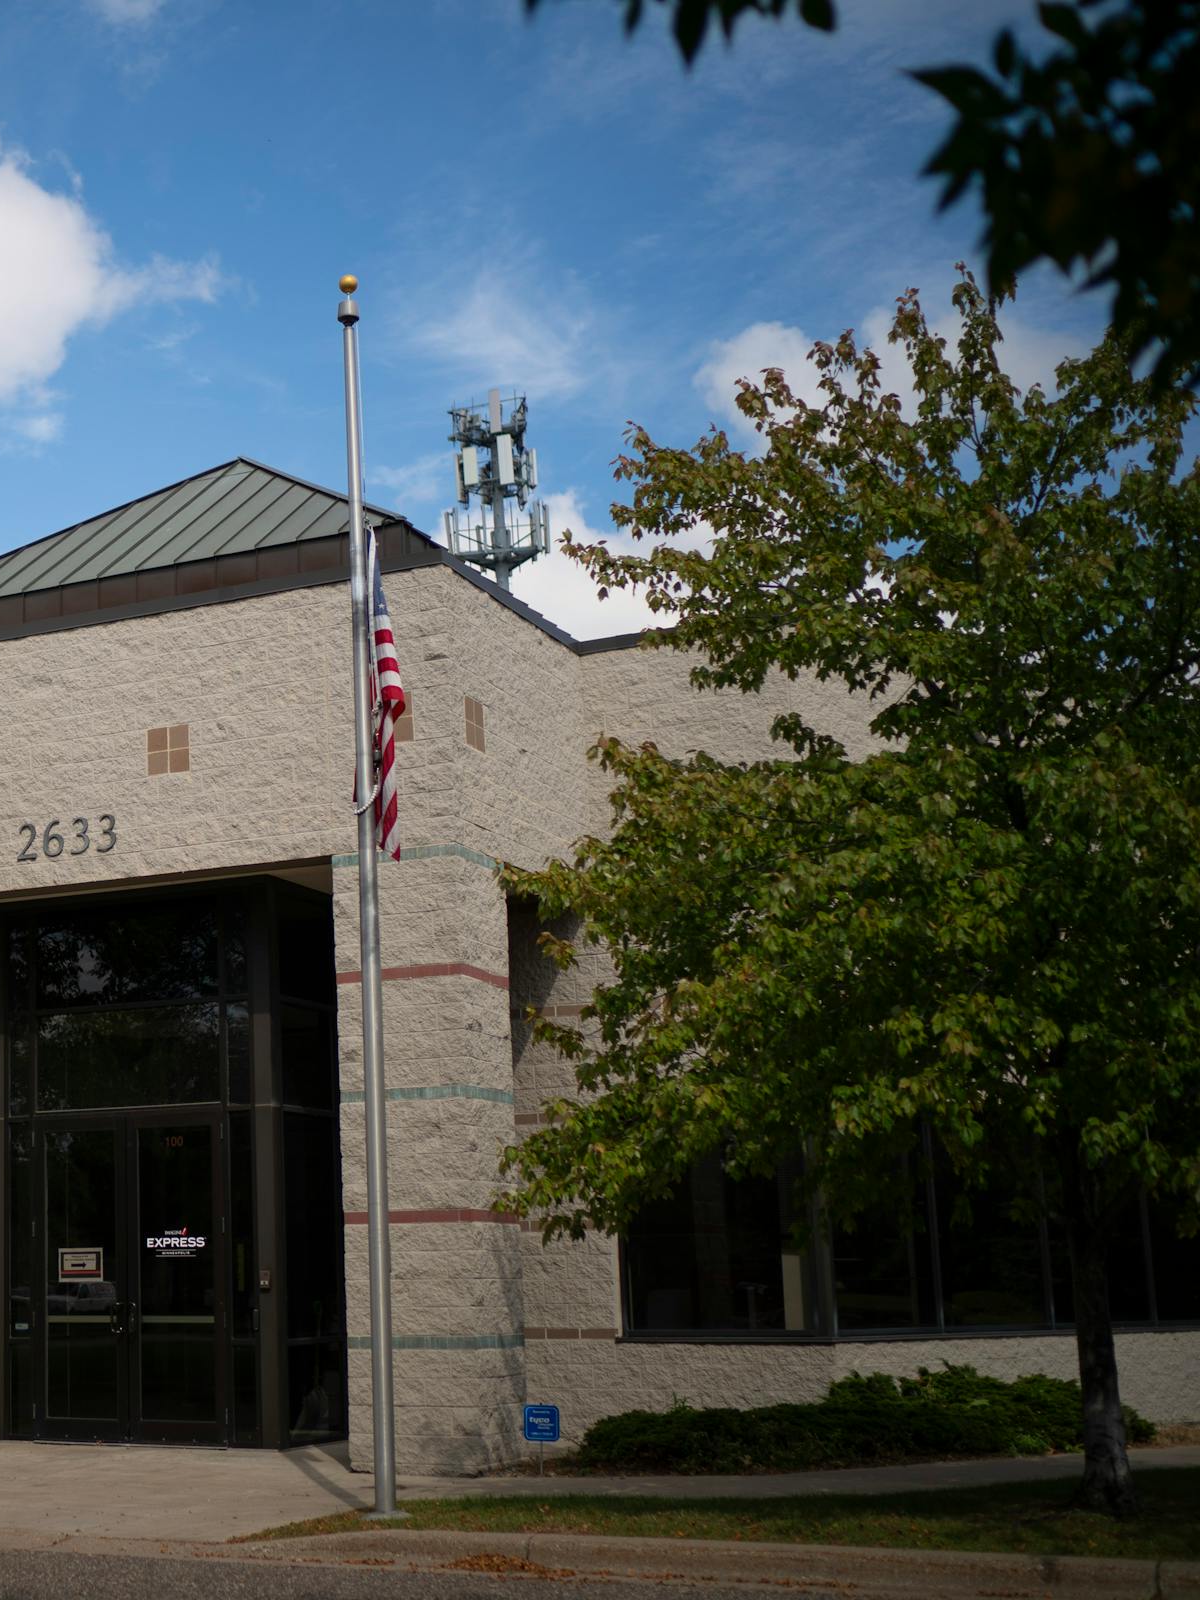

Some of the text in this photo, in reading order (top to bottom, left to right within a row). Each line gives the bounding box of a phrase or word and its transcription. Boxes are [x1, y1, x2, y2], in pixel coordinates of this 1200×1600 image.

[17, 814, 117, 862] 2633
[165, 1135, 184, 1147] 100
[146, 1237, 205, 1248] EXPRESS
[529, 1416, 550, 1424] tyco
